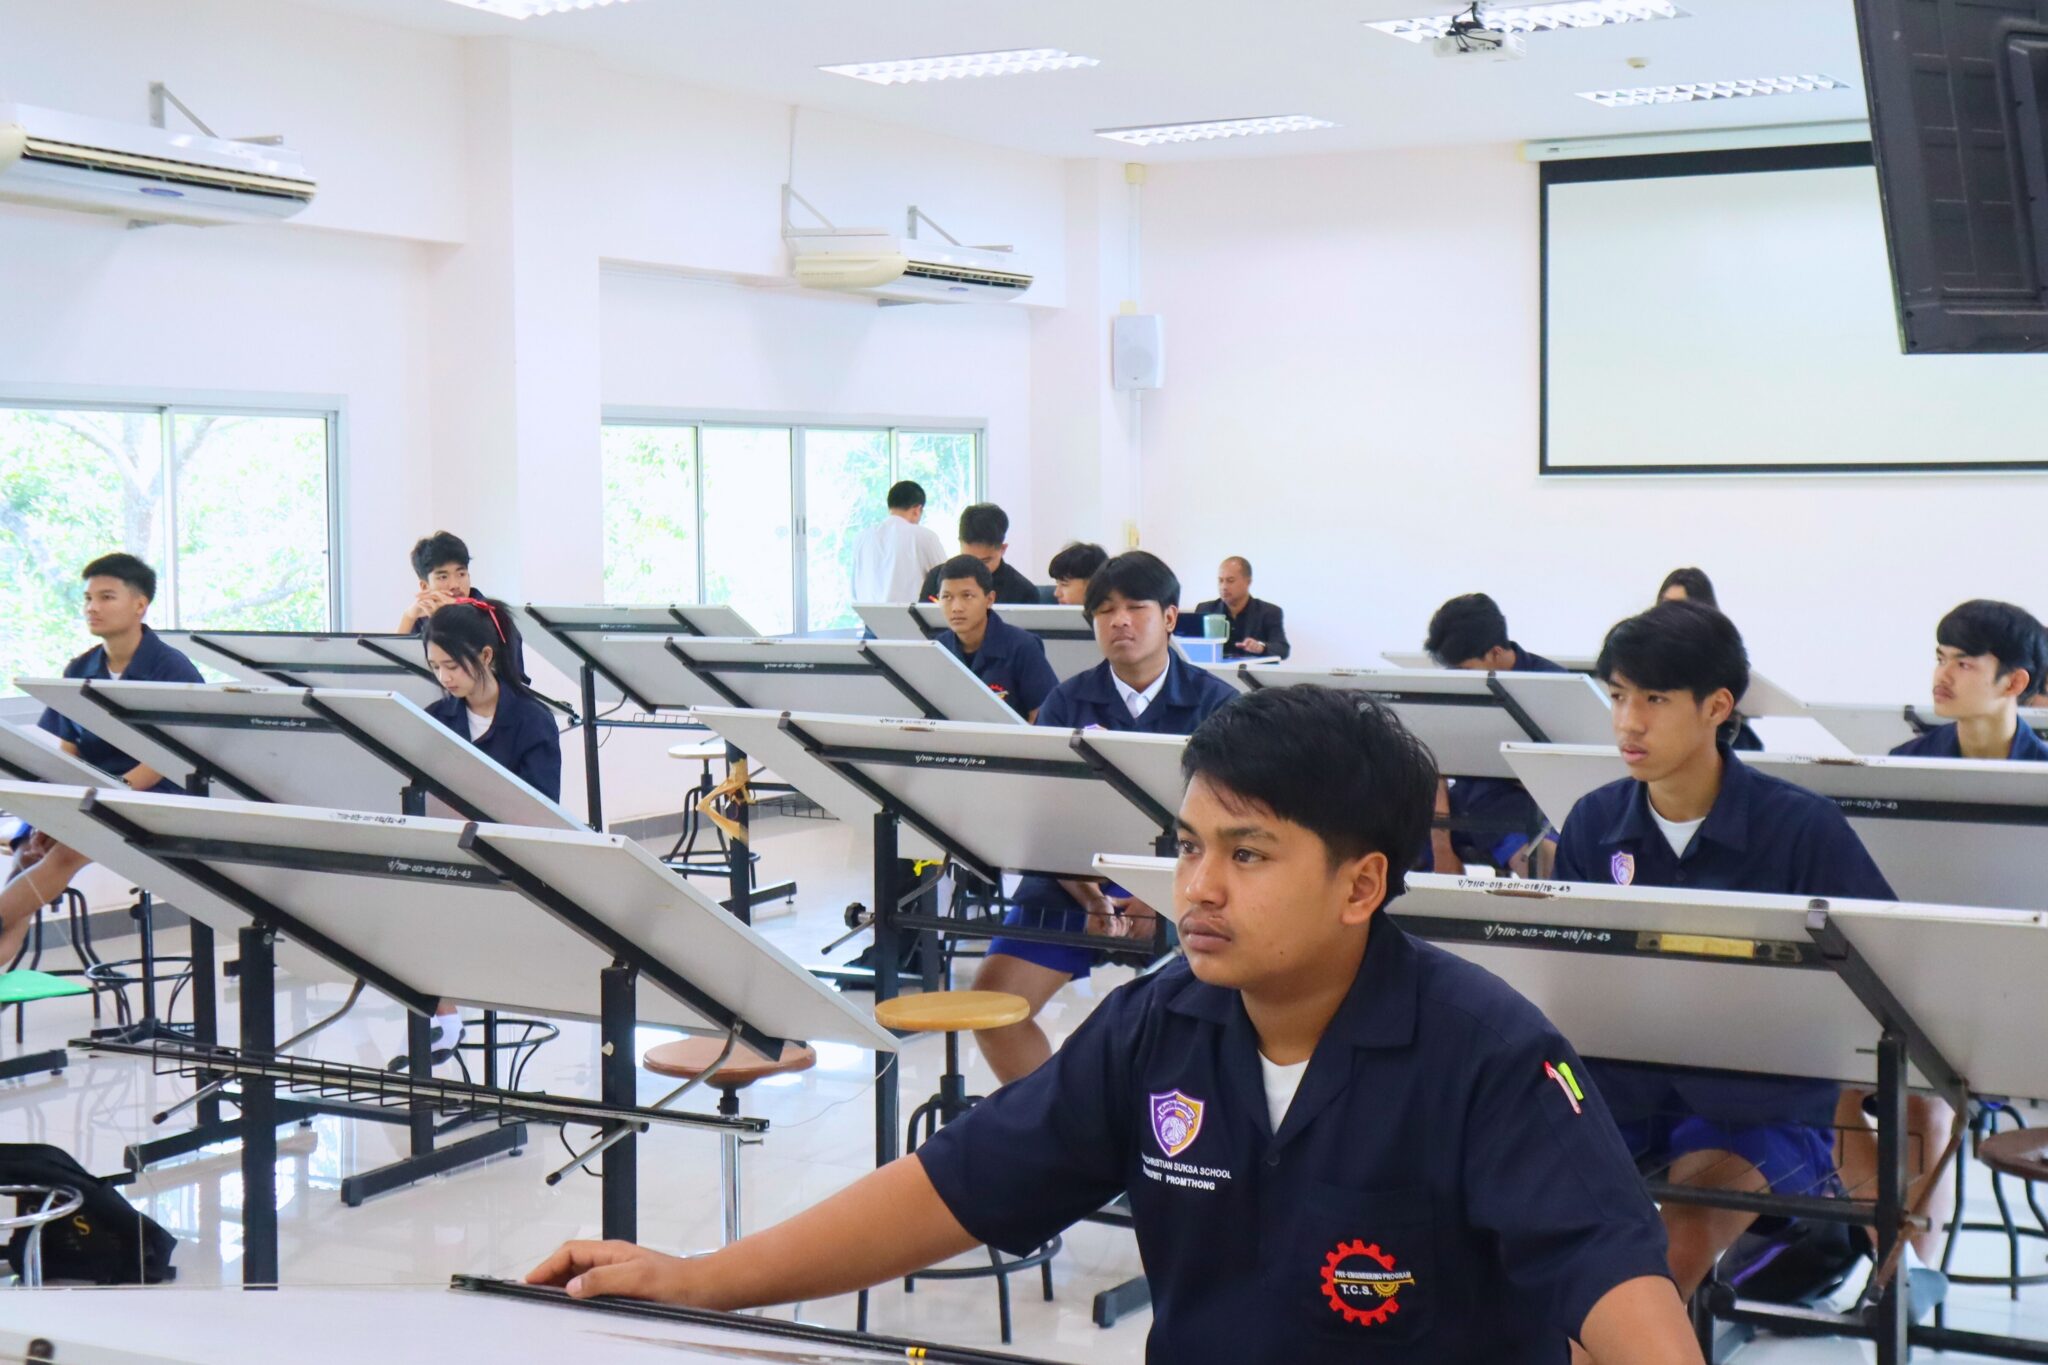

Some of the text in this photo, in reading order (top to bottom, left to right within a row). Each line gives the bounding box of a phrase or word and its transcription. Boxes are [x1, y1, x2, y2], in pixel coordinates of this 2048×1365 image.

[1174, 1163, 1198, 1174] SUKSA
[1200, 1167, 1232, 1179] SCHOOL
[1166, 1175, 1215, 1190] PROMTHONG
[1382, 1272, 1411, 1280] PROGRAM
[1341, 1284, 1372, 1295] T.C.S.
